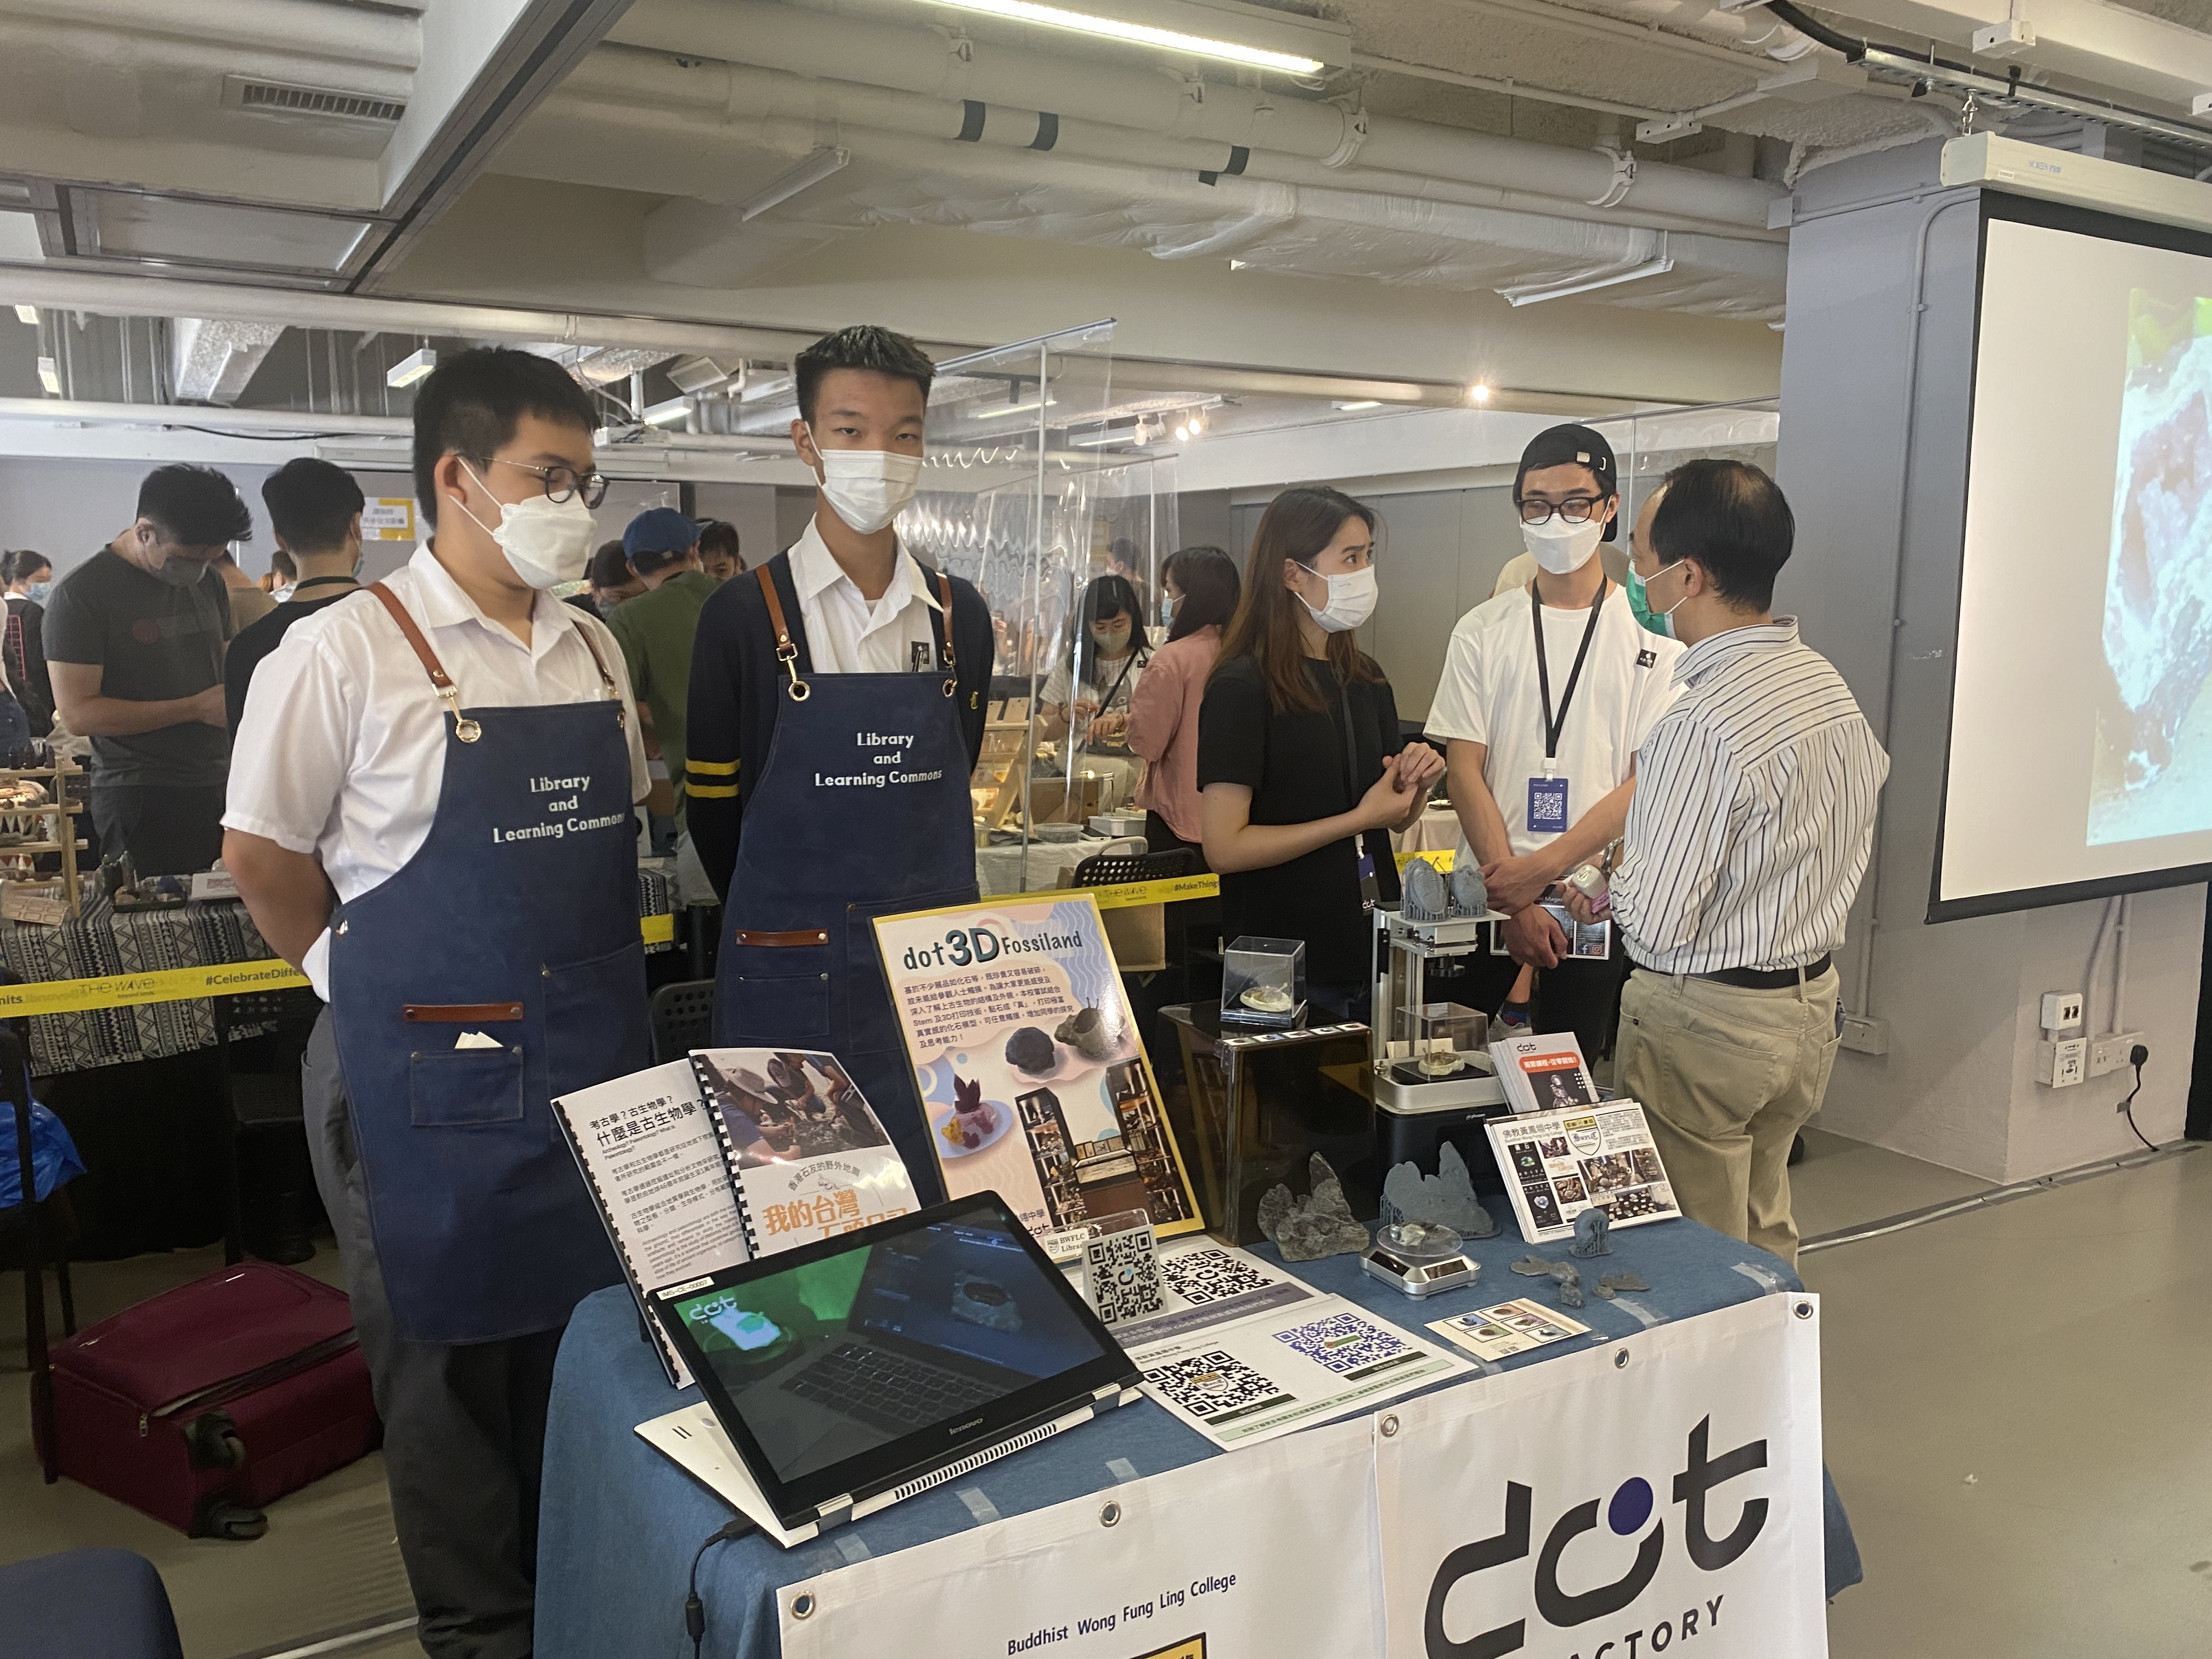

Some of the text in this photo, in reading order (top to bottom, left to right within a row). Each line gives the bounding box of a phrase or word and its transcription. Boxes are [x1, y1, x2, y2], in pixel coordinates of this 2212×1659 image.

[857, 732, 914, 748] Library
[873, 751, 901, 764] and
[530, 776, 590, 793] Library
[815, 770, 943, 788] Learning Commons
[549, 795, 578, 812] and
[494, 822, 563, 843] Learning
[904, 927, 1084, 970] dot 3D Fossiland
[913, 1018, 933, 1026] Stem
[761, 1188, 860, 1236] 我的台灣
[1060, 1233, 1085, 1244] BWFLC
[1425, 1414, 1769, 1659] dot
[1008, 1574, 1236, 1656] Buddhist Wong Fung Ling College
